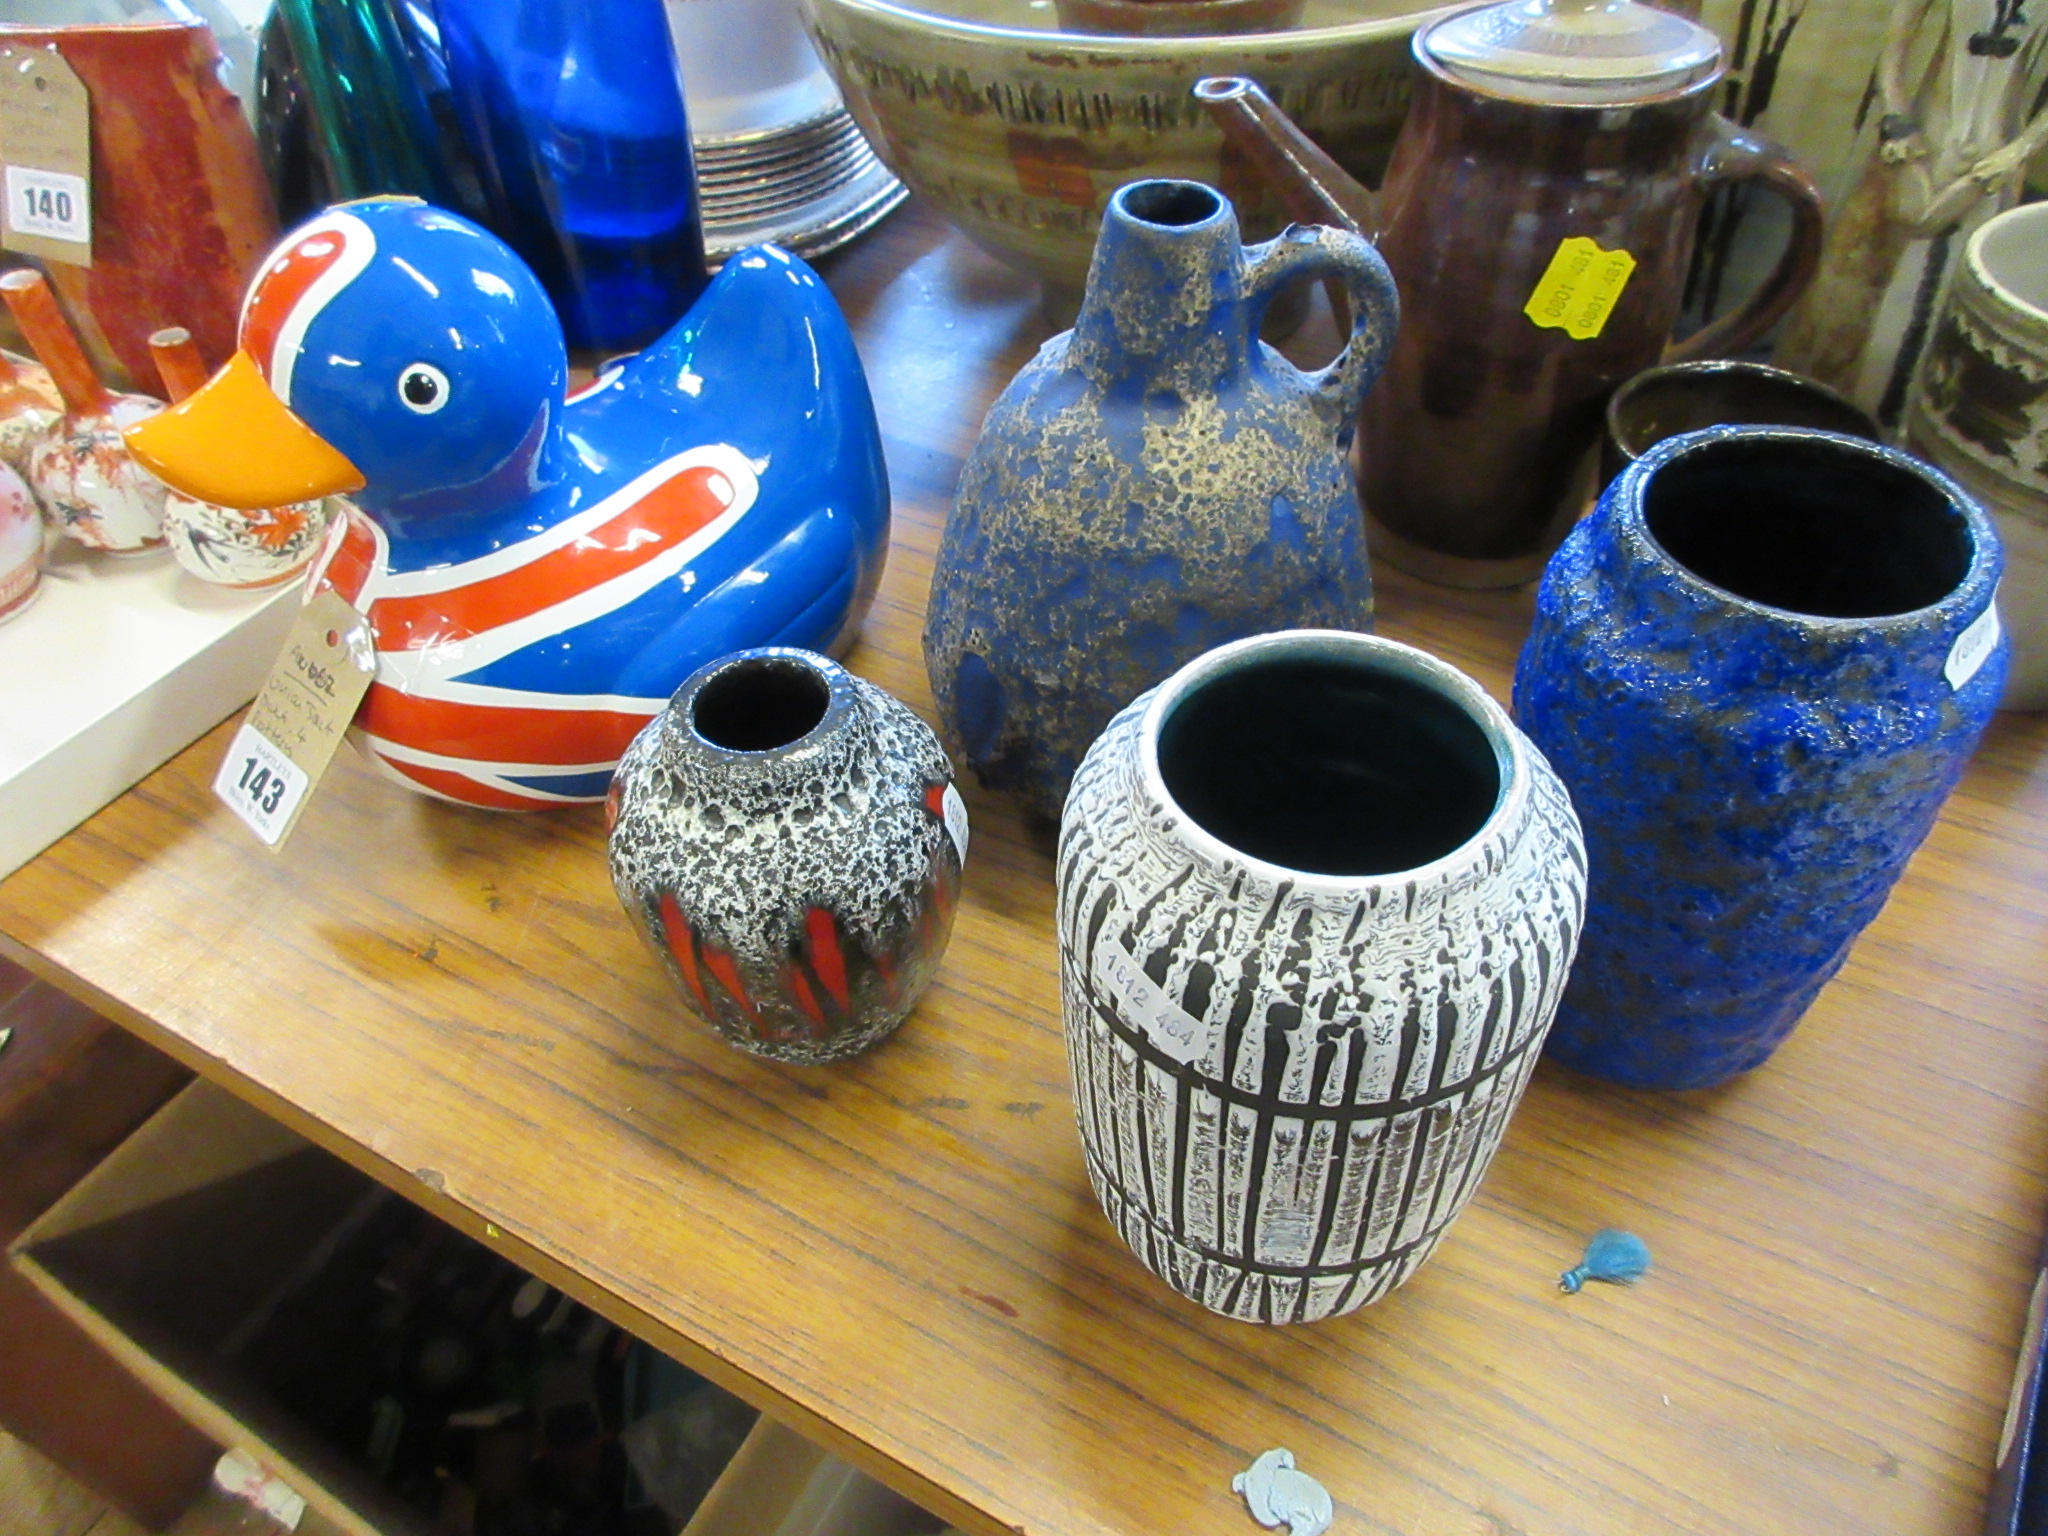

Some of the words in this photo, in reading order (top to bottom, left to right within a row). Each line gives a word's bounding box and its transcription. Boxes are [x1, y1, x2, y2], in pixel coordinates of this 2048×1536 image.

[23, 187, 72, 223] 140
[255, 743, 292, 779] HARTLEYS
[239, 757, 286, 815] 143
[1107, 954, 1149, 1007] 1812
